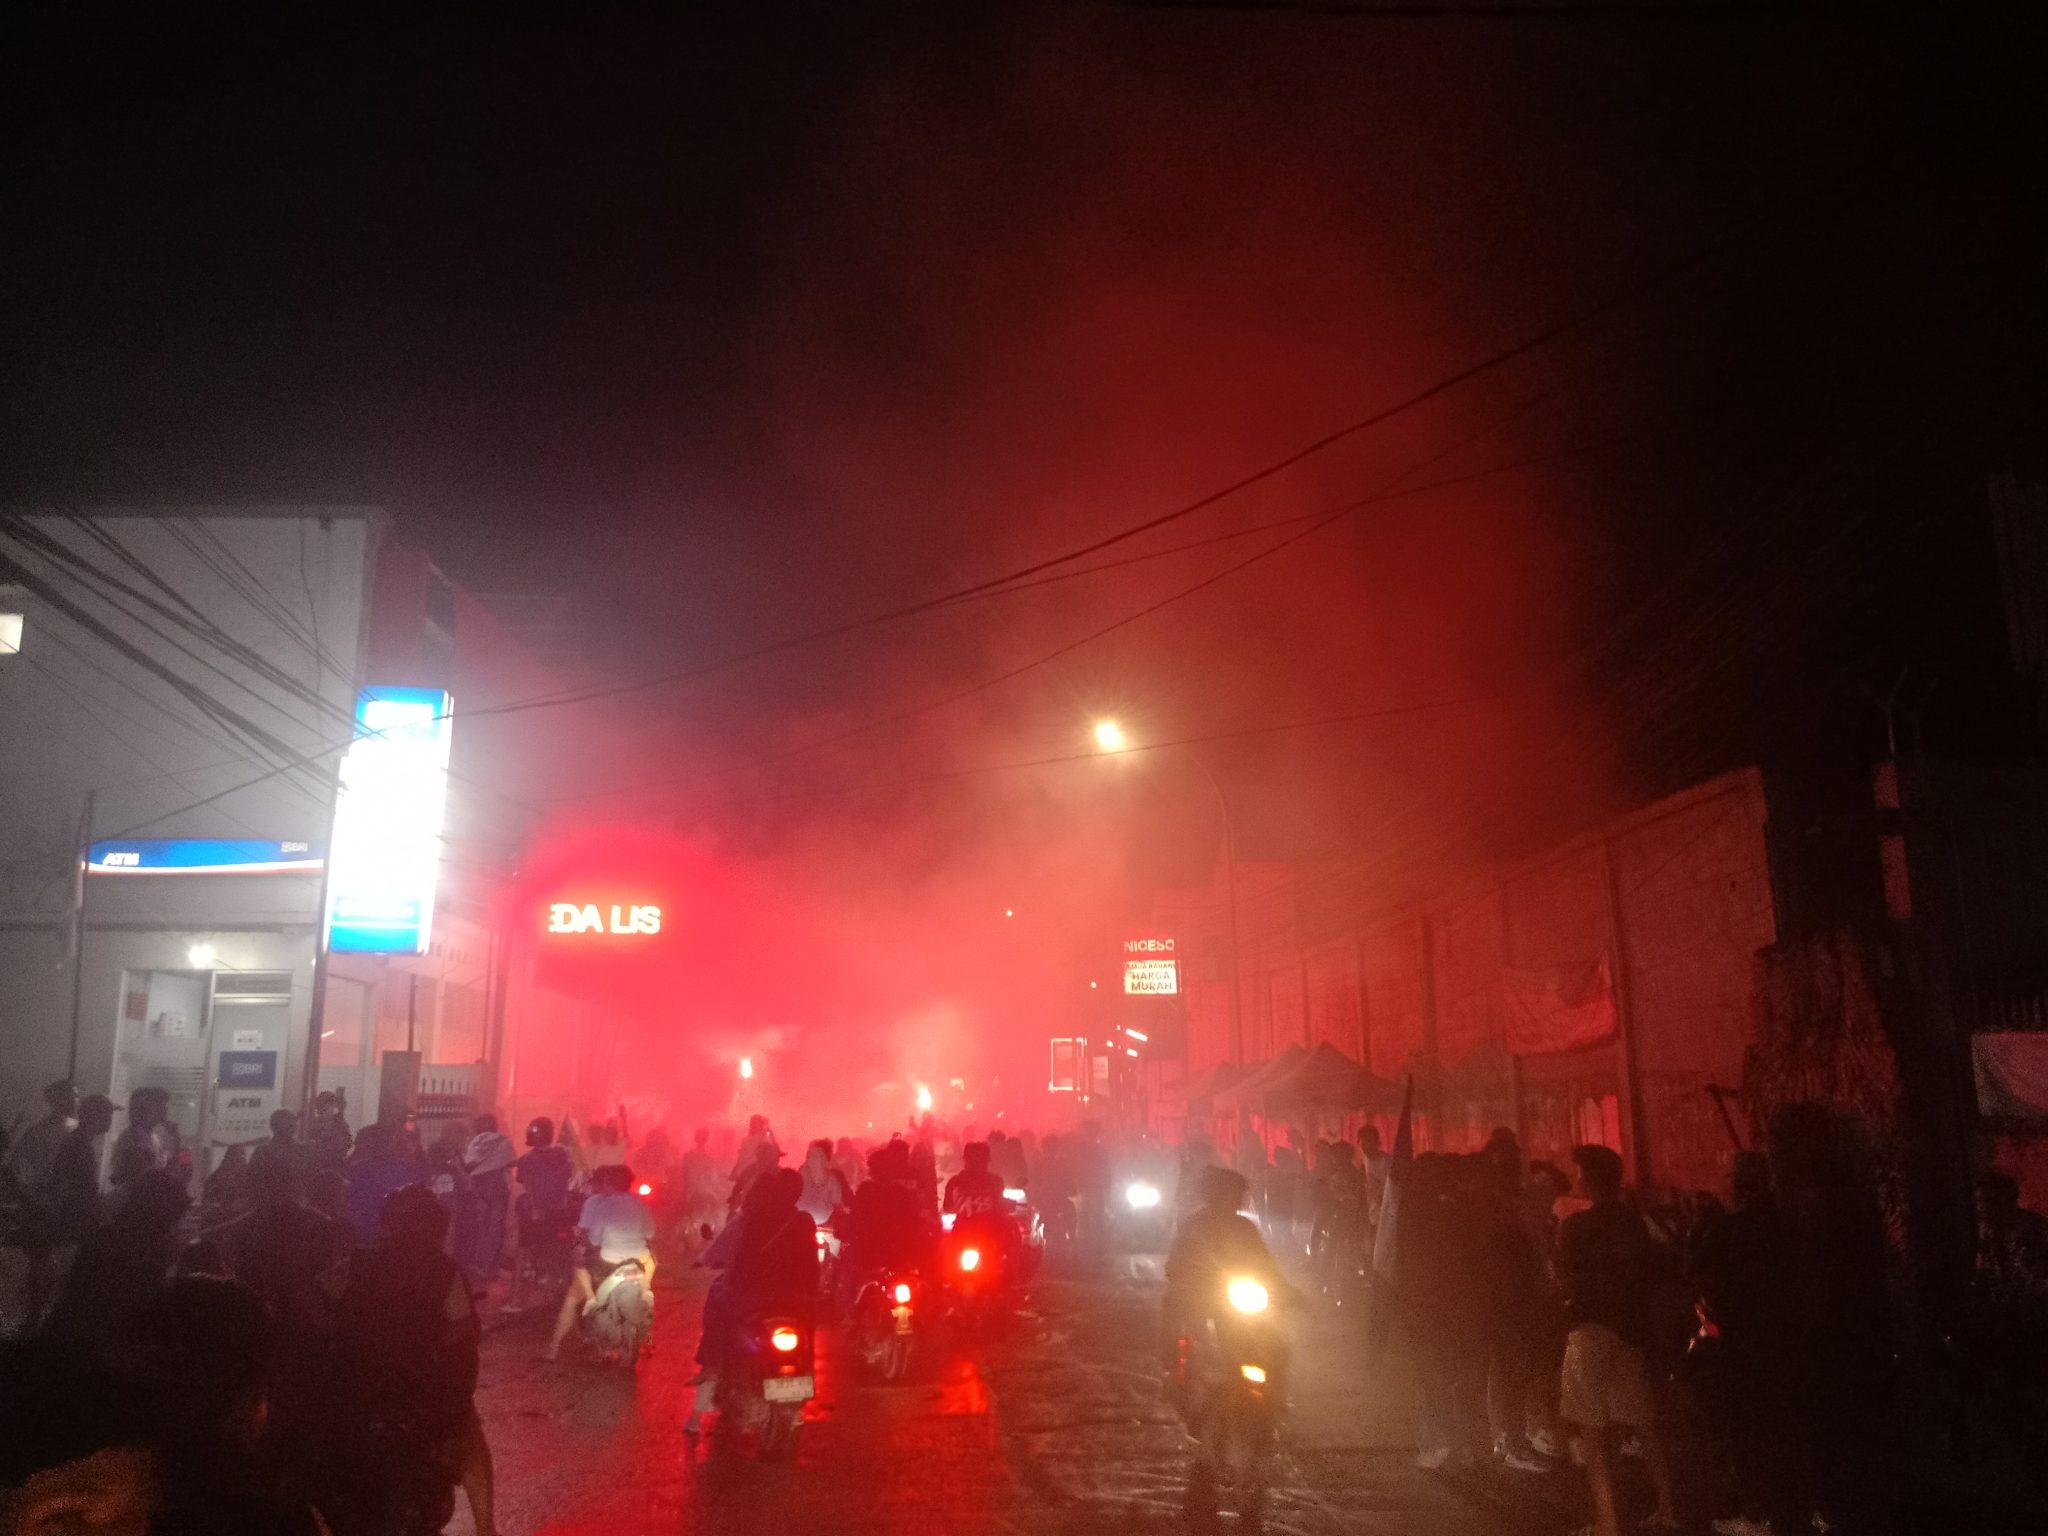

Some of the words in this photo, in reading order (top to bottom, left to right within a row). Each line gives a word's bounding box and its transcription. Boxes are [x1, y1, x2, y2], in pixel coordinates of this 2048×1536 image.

[102, 852, 140, 866] ATM
[1124, 938, 1175, 953] NICESO
[1131, 981, 1173, 991] MURAH
[226, 1097, 262, 1108] ATM
